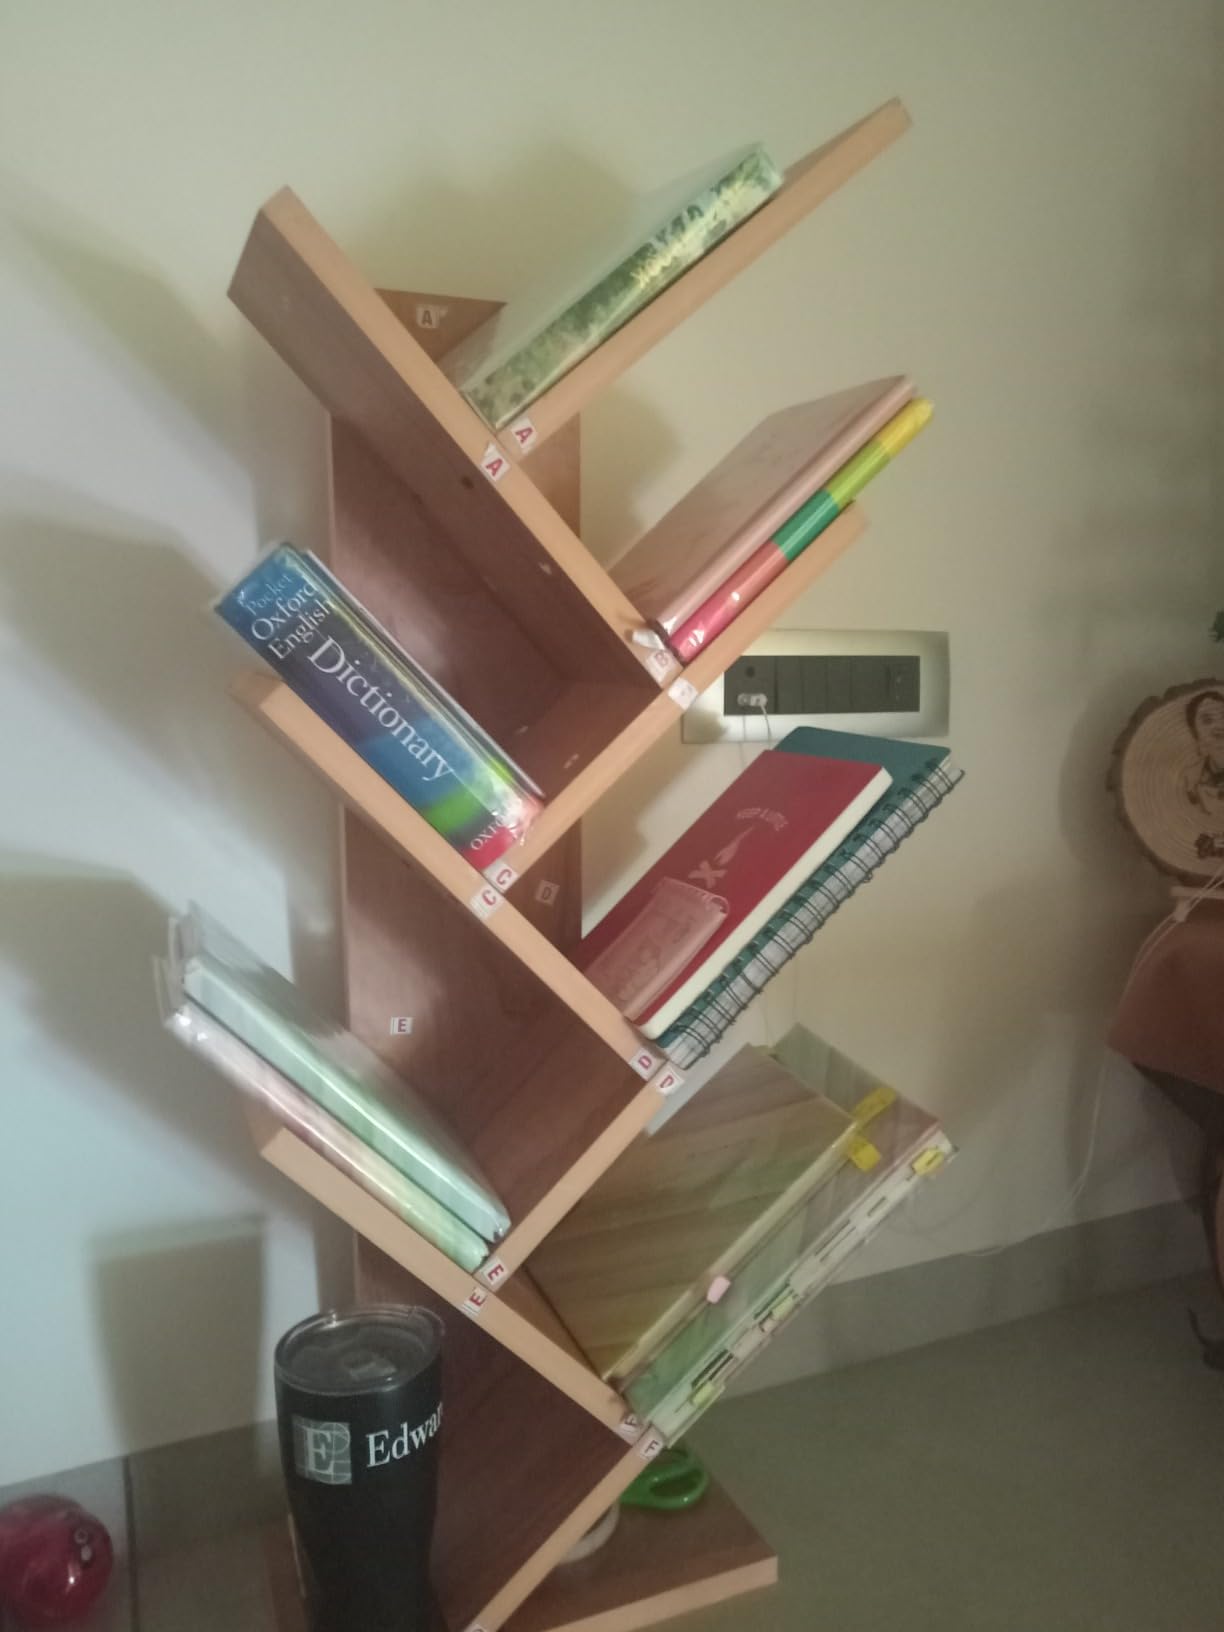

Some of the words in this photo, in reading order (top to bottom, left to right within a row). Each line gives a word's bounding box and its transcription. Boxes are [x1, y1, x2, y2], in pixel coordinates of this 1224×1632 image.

[421, 309, 433, 326] A
[515, 426, 534, 445] A
[485, 457, 504, 477] A
[245, 573, 293, 616] Pocket
[251, 583, 319, 640] Oxford
[307, 635, 454, 782] Dictionary
[496, 868, 512, 886] C
[481, 889, 498, 907] C
[397, 1018, 408, 1033] E
[637, 1055, 653, 1071] D
[487, 1263, 505, 1281] E
[469, 1290, 488, 1307] E
[644, 1439, 660, 1455] F
